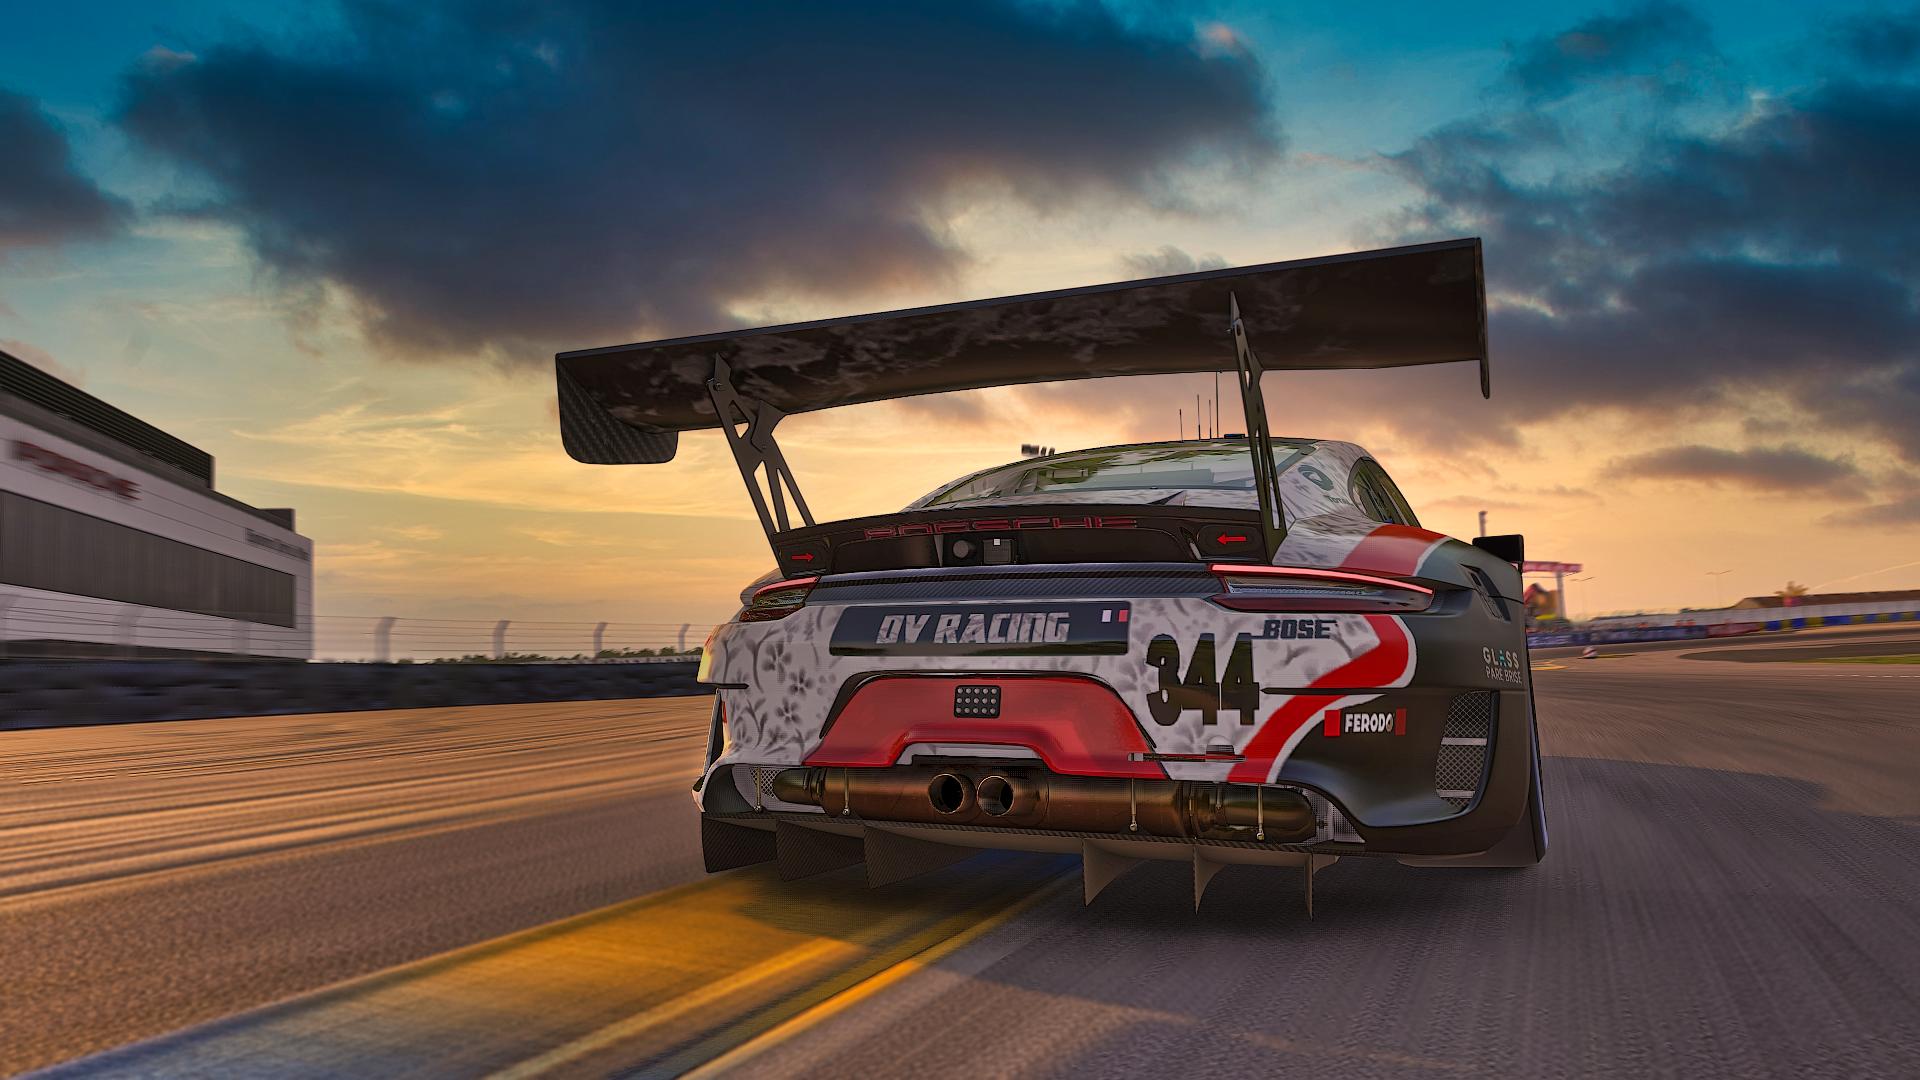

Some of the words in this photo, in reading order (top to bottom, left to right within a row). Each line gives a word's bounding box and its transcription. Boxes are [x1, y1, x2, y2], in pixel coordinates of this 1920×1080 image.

[863, 516, 1137, 540] PORSCHE
[933, 612, 1070, 644] RACING
[1263, 619, 1338, 639] BOSE
[1145, 633, 1260, 726] 344
[1485, 665, 1504, 681] PARE
[1344, 713, 1394, 733] FERODO
